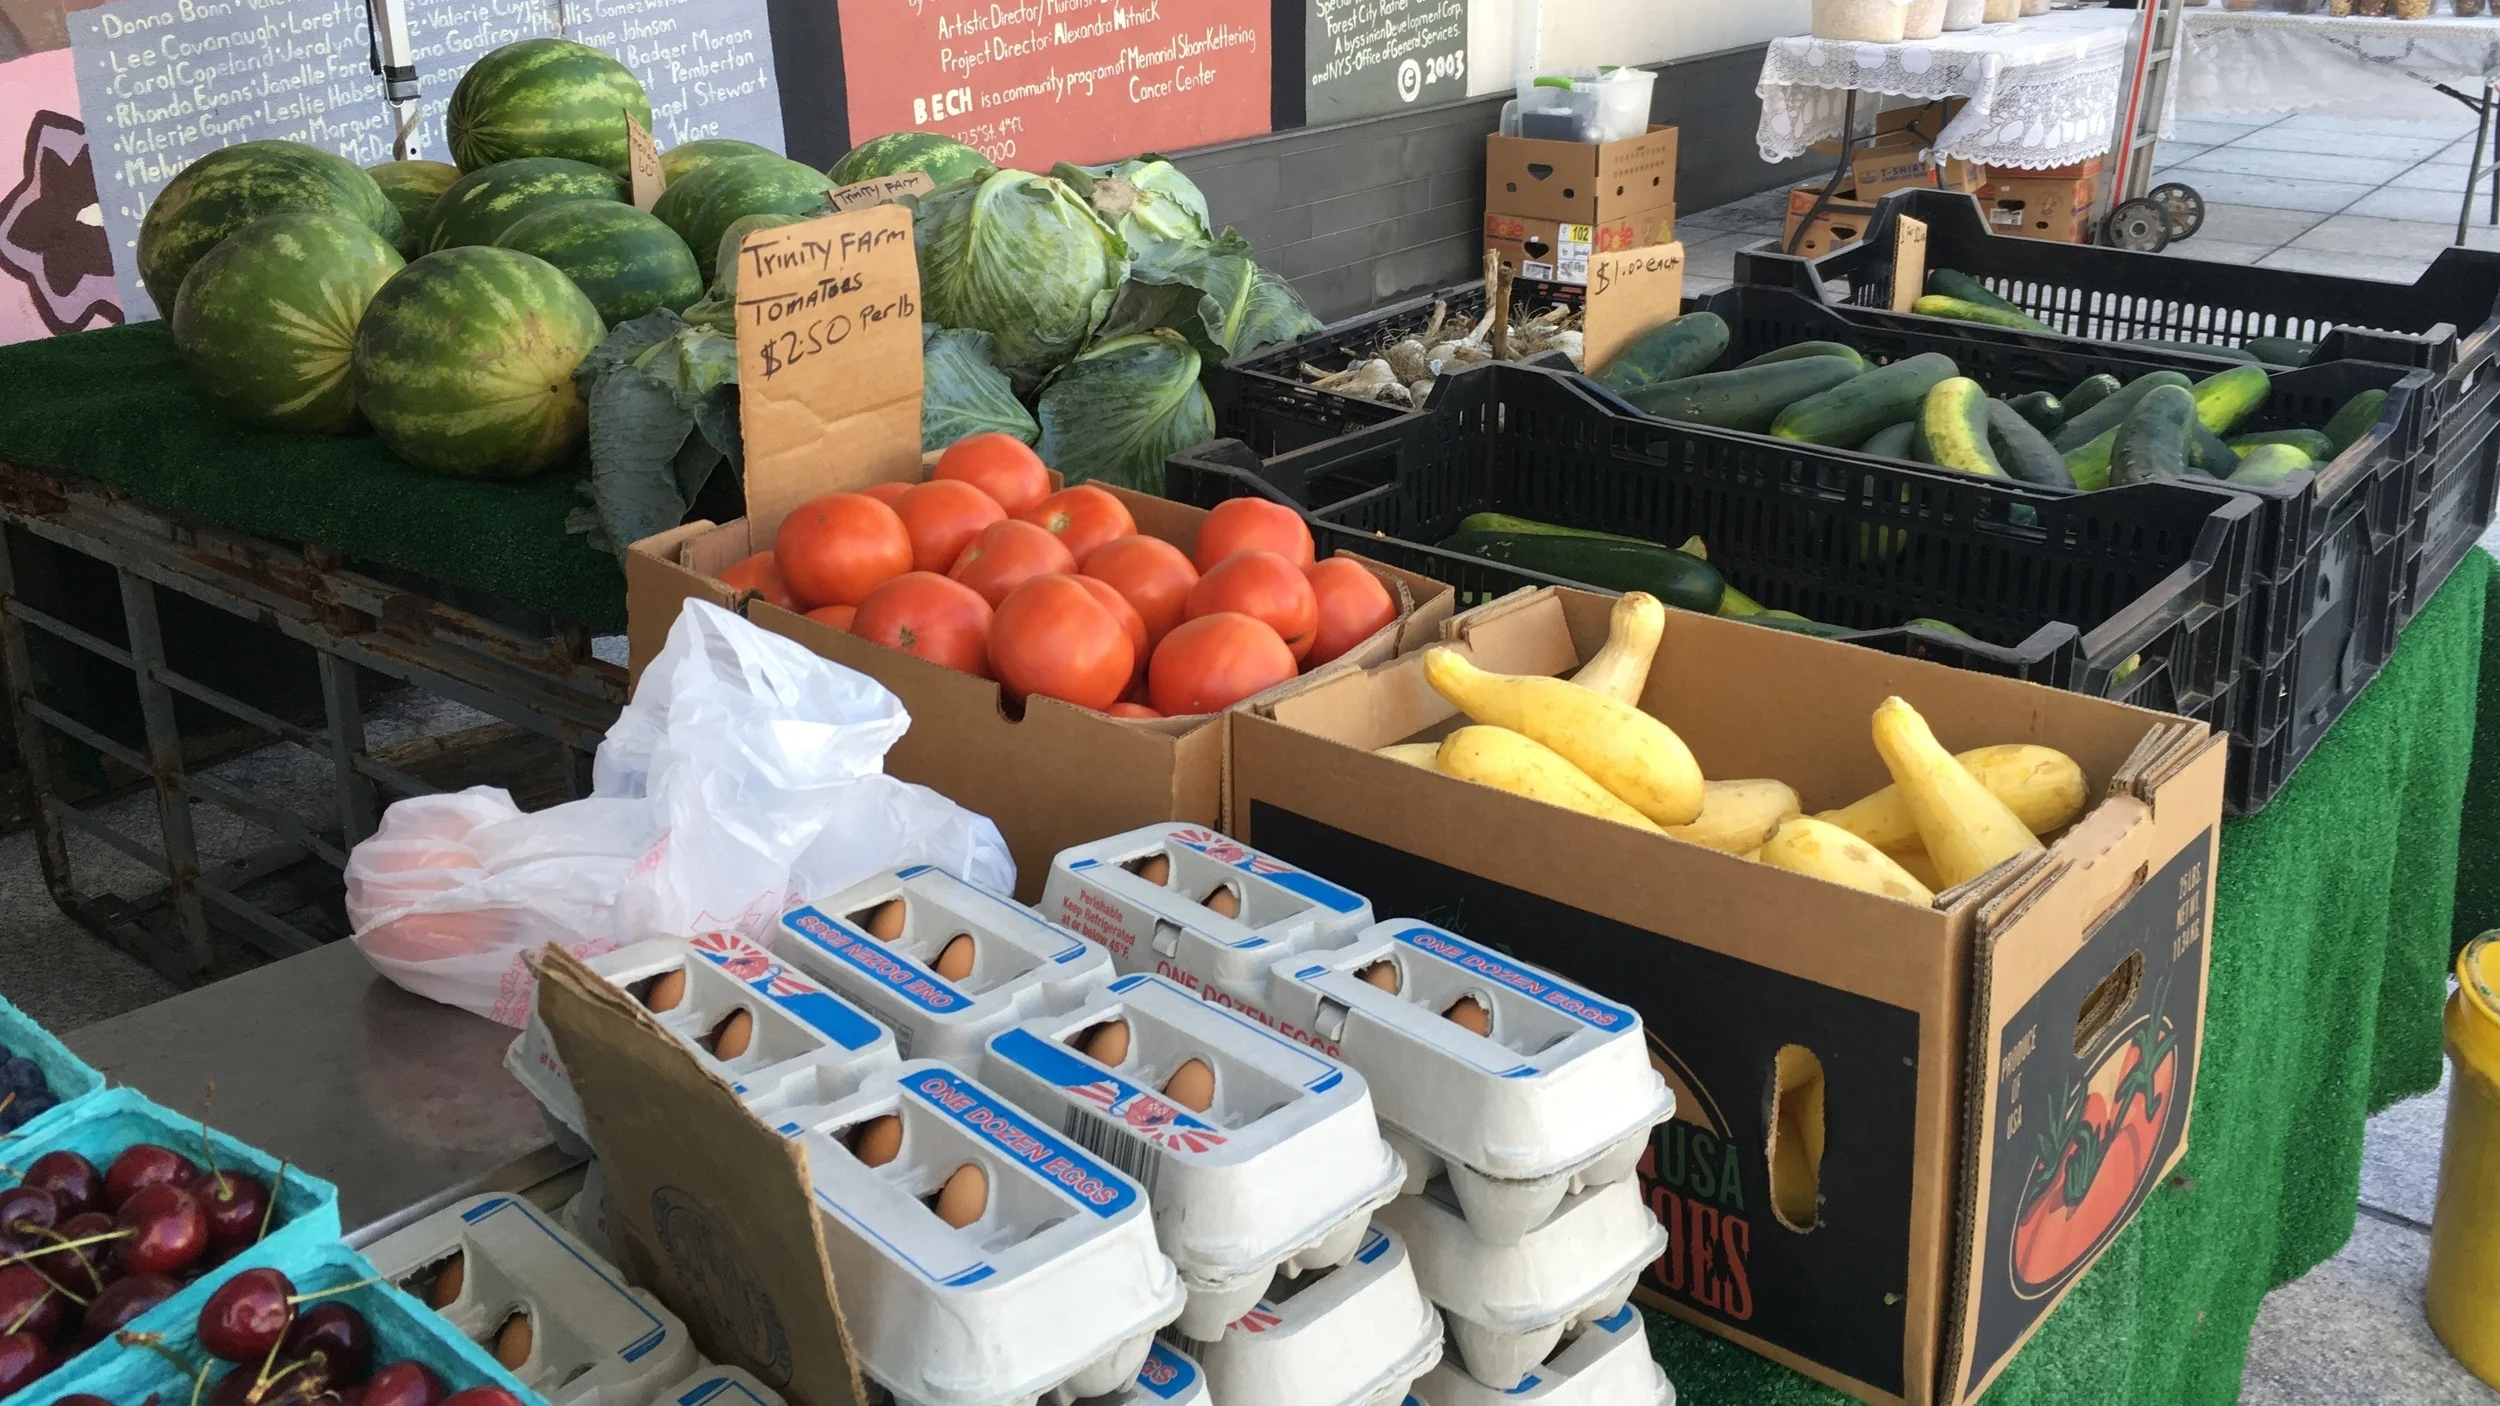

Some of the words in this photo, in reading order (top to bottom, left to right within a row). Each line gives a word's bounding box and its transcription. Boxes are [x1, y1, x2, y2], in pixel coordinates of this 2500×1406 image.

[110, 50, 157, 73] Lee
[288, 0, 367, 35] Loretta
[938, 9, 990, 41] Artistic
[1326, 8, 1357, 38] Forest
[1358, 5, 1378, 28] City
[1334, 26, 1386, 58] Abyssinian
[1385, 3, 1442, 39] Development
[113, 64, 176, 99] Carol
[175, 46, 274, 91] Copeland
[427, 4, 489, 29] Valerie
[627, 40, 688, 70] Badger
[692, 27, 753, 53] Morgan
[671, 49, 755, 84] Pemberton
[940, 40, 991, 79] Project
[1054, 13, 1113, 46] Alexandra
[1312, 63, 1329, 86] and
[1389, 31, 1421, 59] General
[1424, 49, 1465, 85] 2003
[115, 91, 194, 128] Rhonda
[194, 84, 252, 110] Evans
[257, 63, 325, 97] Janelle
[446, 21, 519, 53] Godfrey
[120, 124, 198, 155] Valerie
[200, 113, 255, 138] Gunn
[263, 92, 326, 124] Leslie
[620, 18, 677, 43] Johnson
[694, 67, 768, 106] Stewart
[980, 91, 991, 109] is
[1002, 66, 1064, 104] community
[1067, 65, 1115, 96] program
[1115, 49, 1127, 76] of
[1127, 36, 1177, 71] Memorial
[1128, 75, 1173, 104] Cancer
[1175, 61, 1217, 92] Center
[1572, 226, 1589, 242] 102
[1063, 896, 1083, 918] Keep
[1085, 907, 1136, 946] Refrigerated
[1080, 889, 1124, 923] Perishable
[796, 915, 853, 948] EGGS
[1061, 914, 1071, 926] at
[1072, 920, 1081, 931] or
[1082, 923, 1108, 946] below
[844, 943, 915, 984] DOZEN
[1155, 960, 1199, 991] ONE
[1412, 934, 1467, 959] ONE
[1462, 953, 1547, 995] DOZEN
[1542, 990, 1619, 1027] EGGS
[902, 979, 954, 1007] ONE
[920, 1078, 977, 1113] ONE
[964, 1105, 1053, 1163] DOZEN
[1041, 1156, 1119, 1205] EGGS
[2006, 1104, 2022, 1140] USA
[1660, 1121, 1745, 1212] USA
